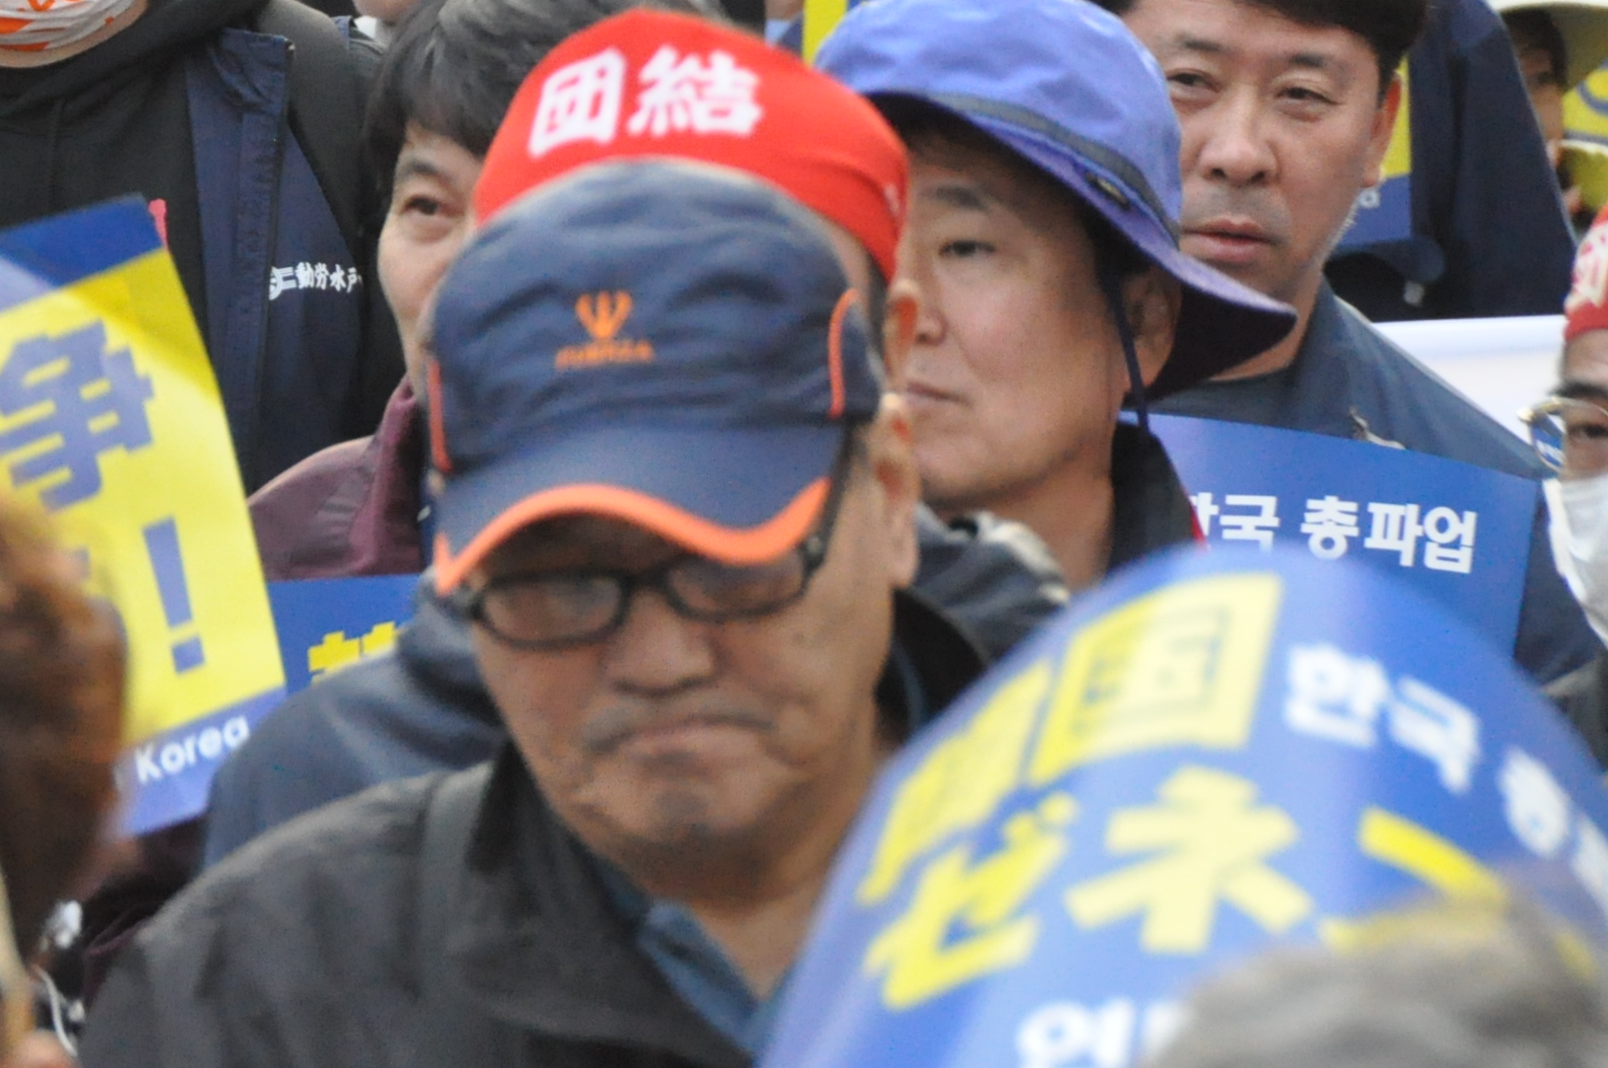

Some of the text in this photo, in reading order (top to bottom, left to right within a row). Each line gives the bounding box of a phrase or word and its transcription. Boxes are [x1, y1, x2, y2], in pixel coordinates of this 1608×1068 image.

[527, 42, 765, 159] 団結
[1300, 494, 1479, 575] 총파업
[134, 715, 251, 784] Korea
